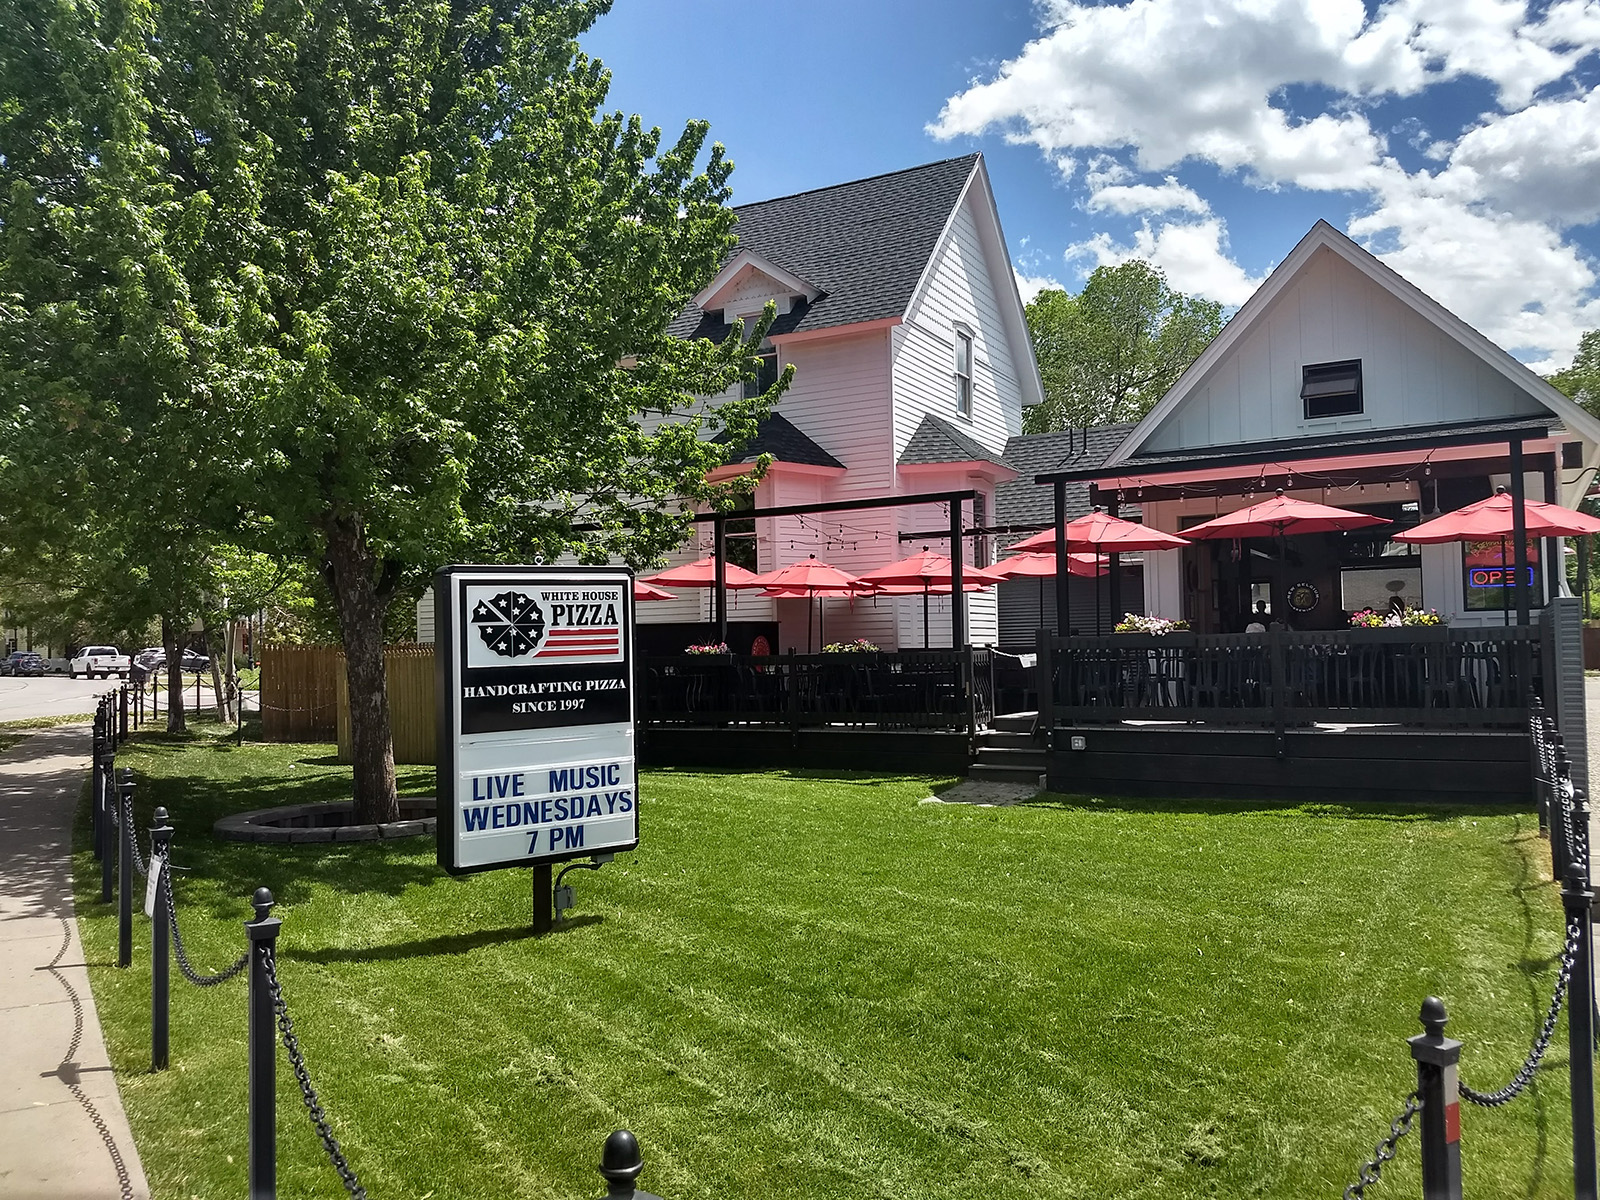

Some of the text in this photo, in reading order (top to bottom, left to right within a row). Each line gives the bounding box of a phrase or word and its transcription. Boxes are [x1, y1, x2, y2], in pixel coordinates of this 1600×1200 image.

[1473, 571, 1520, 585] OPE
[541, 591, 619, 602] WHITE HOUSE
[551, 603, 619, 627] PIZZA
[463, 678, 627, 699] HANDCRAFTING PIZZA
[512, 699, 586, 714] SINCE 1997
[472, 763, 620, 801] LIVE MUSIC
[463, 790, 633, 832] WEDNESDAYS
[526, 824, 584, 855] 7 PM
